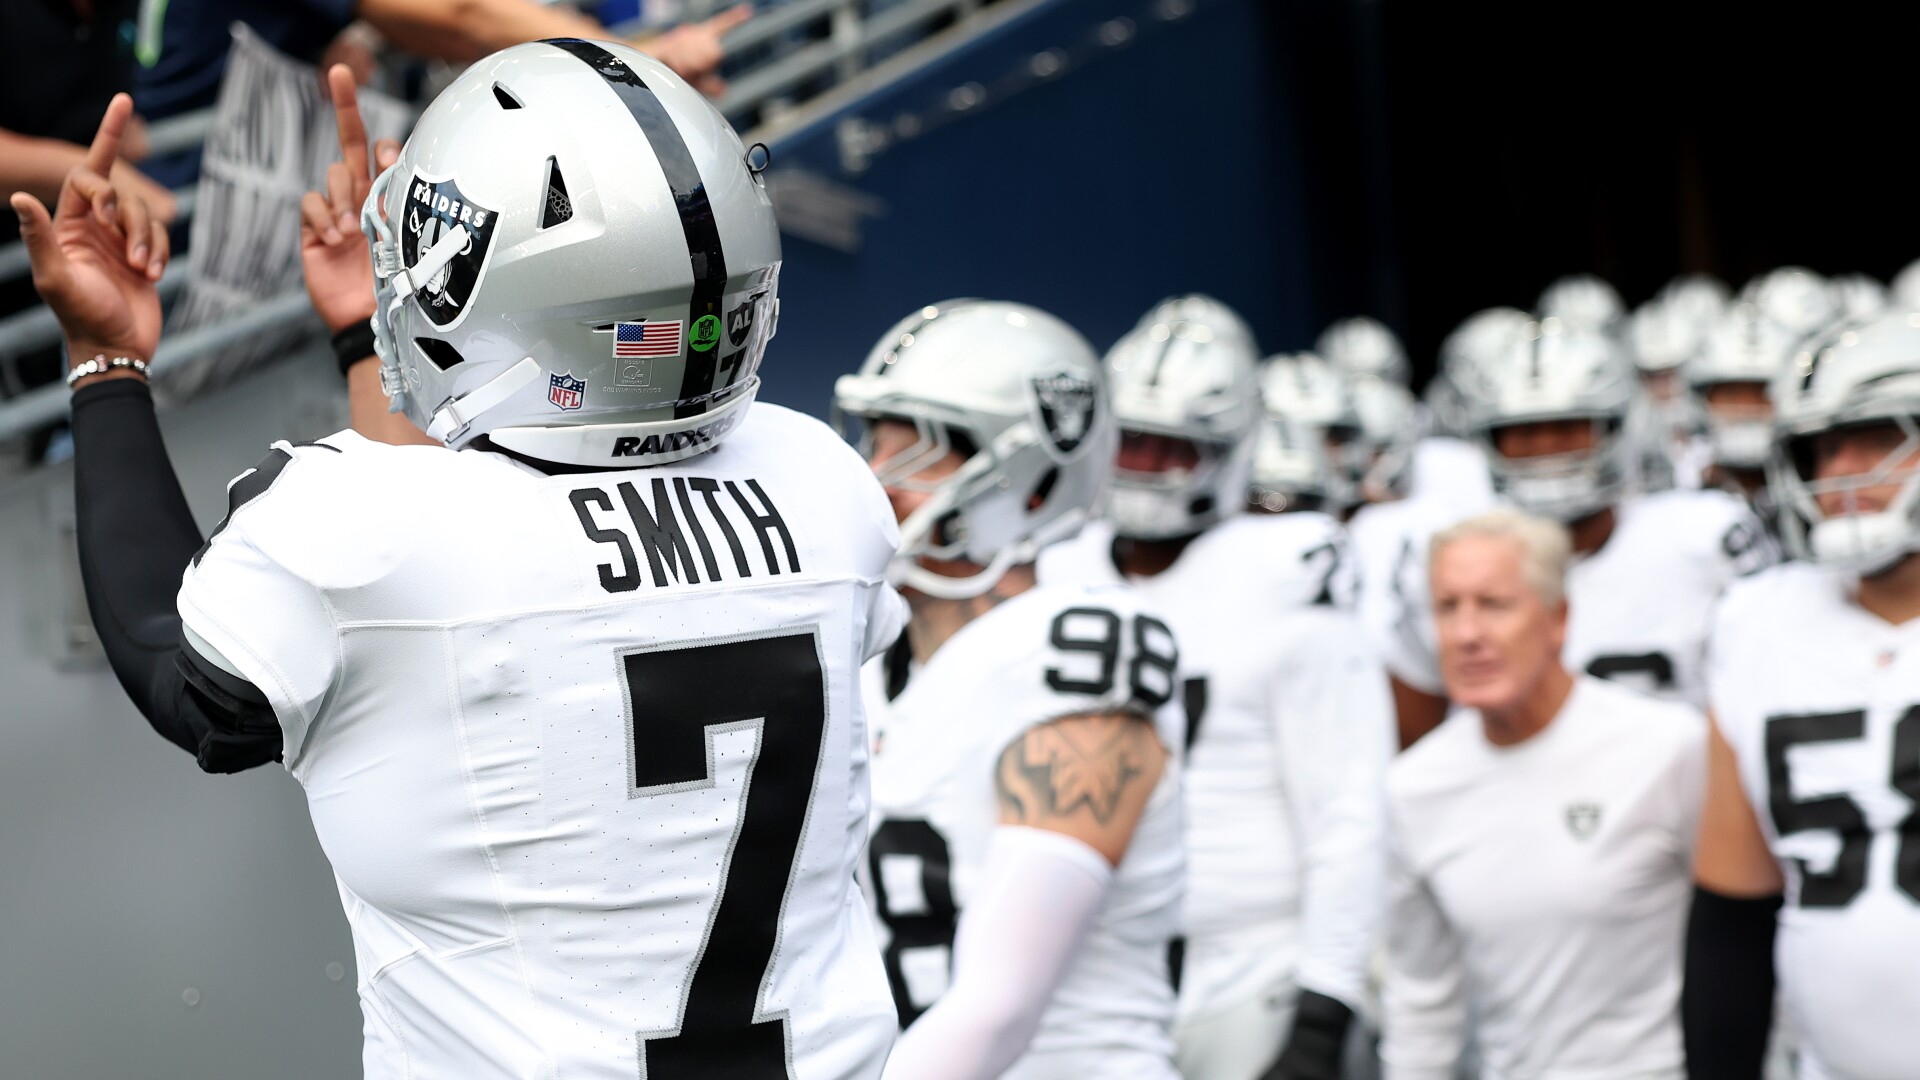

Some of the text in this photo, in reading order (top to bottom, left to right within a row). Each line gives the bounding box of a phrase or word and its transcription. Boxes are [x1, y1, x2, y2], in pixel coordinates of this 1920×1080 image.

[413, 183, 486, 228] RAIDERS
[732, 310, 751, 334] AL
[551, 387, 580, 408] NFL
[611, 410, 737, 458] RAIDERS
[568, 477, 802, 594] SMITH
[1044, 606, 1178, 706] 98
[614, 622, 830, 1080] 7
